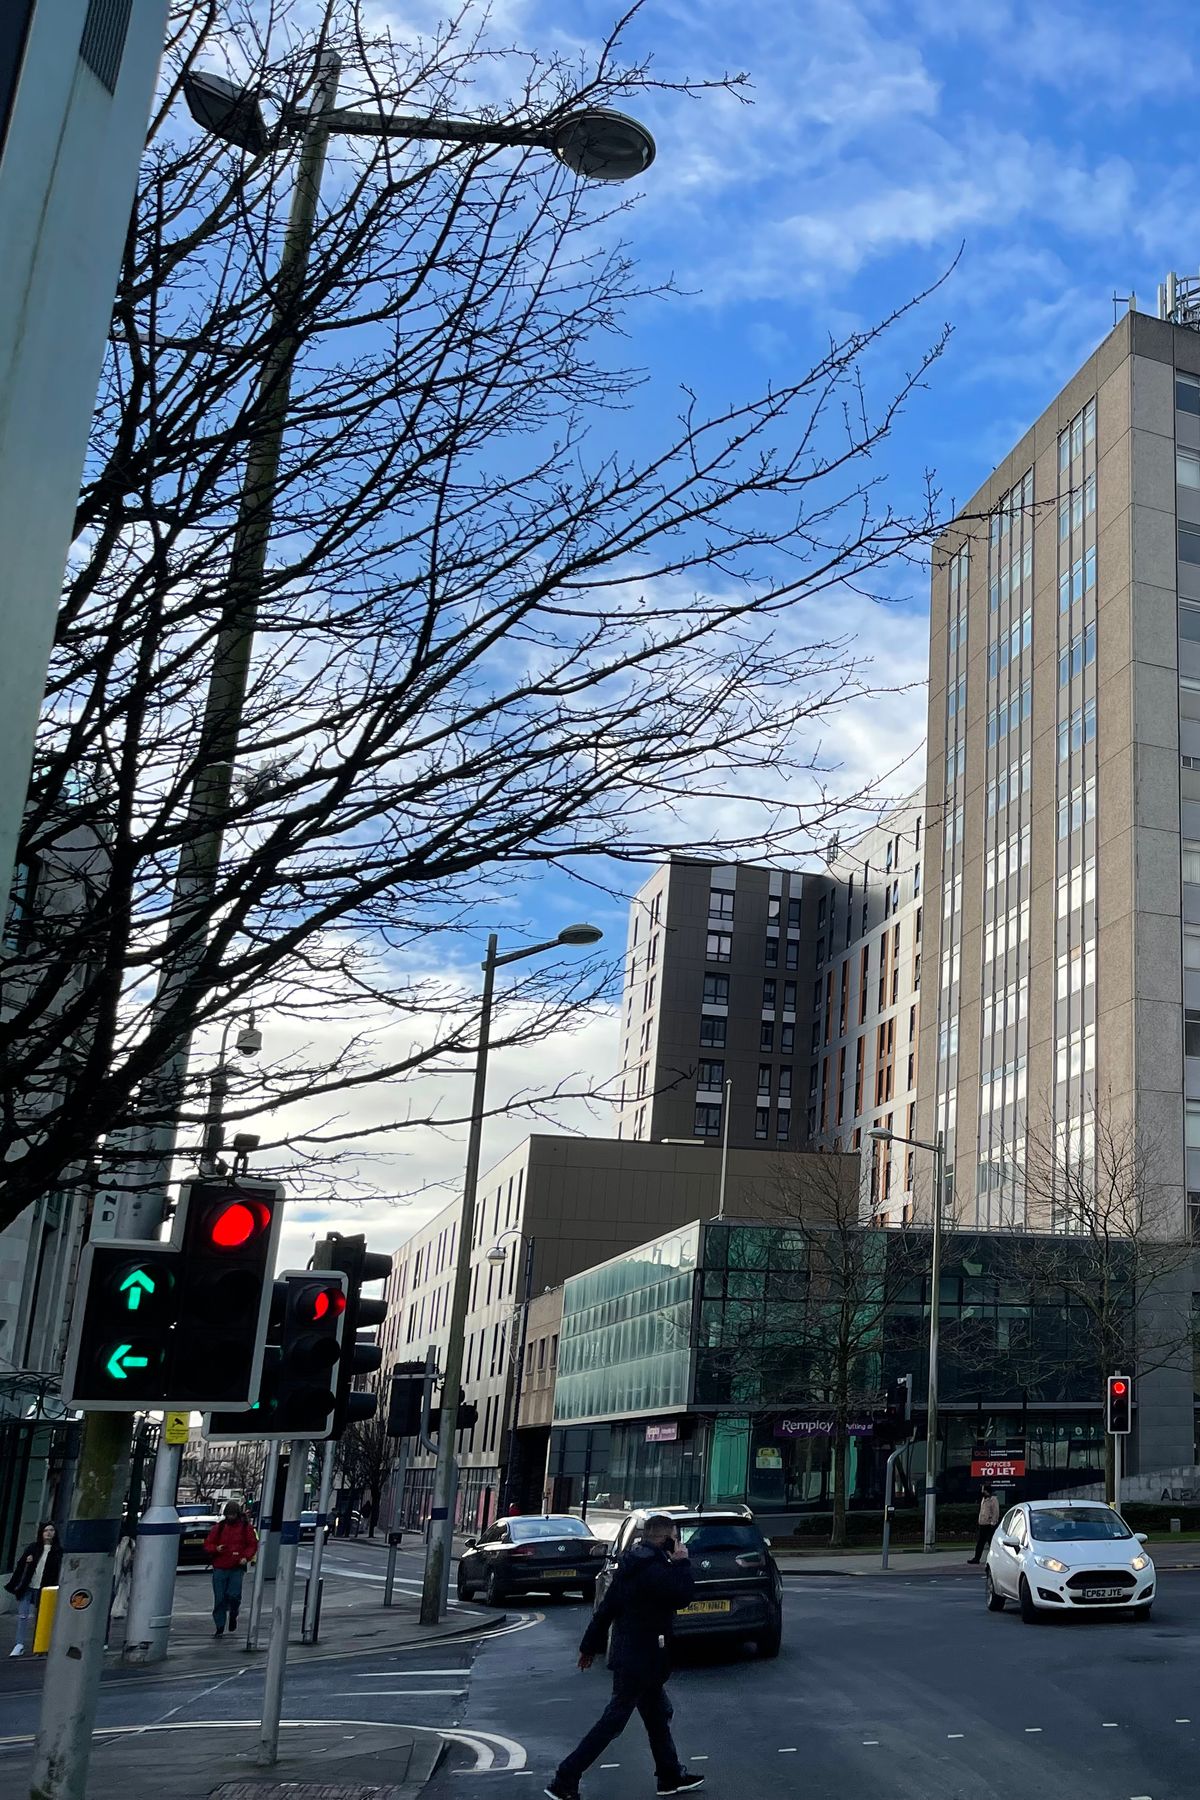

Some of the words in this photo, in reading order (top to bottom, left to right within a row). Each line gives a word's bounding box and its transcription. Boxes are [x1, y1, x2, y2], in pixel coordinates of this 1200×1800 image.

[782, 1420, 833, 1433] Remploy
[980, 1467, 995, 1476] TO
[996, 1467, 1016, 1476] LET
